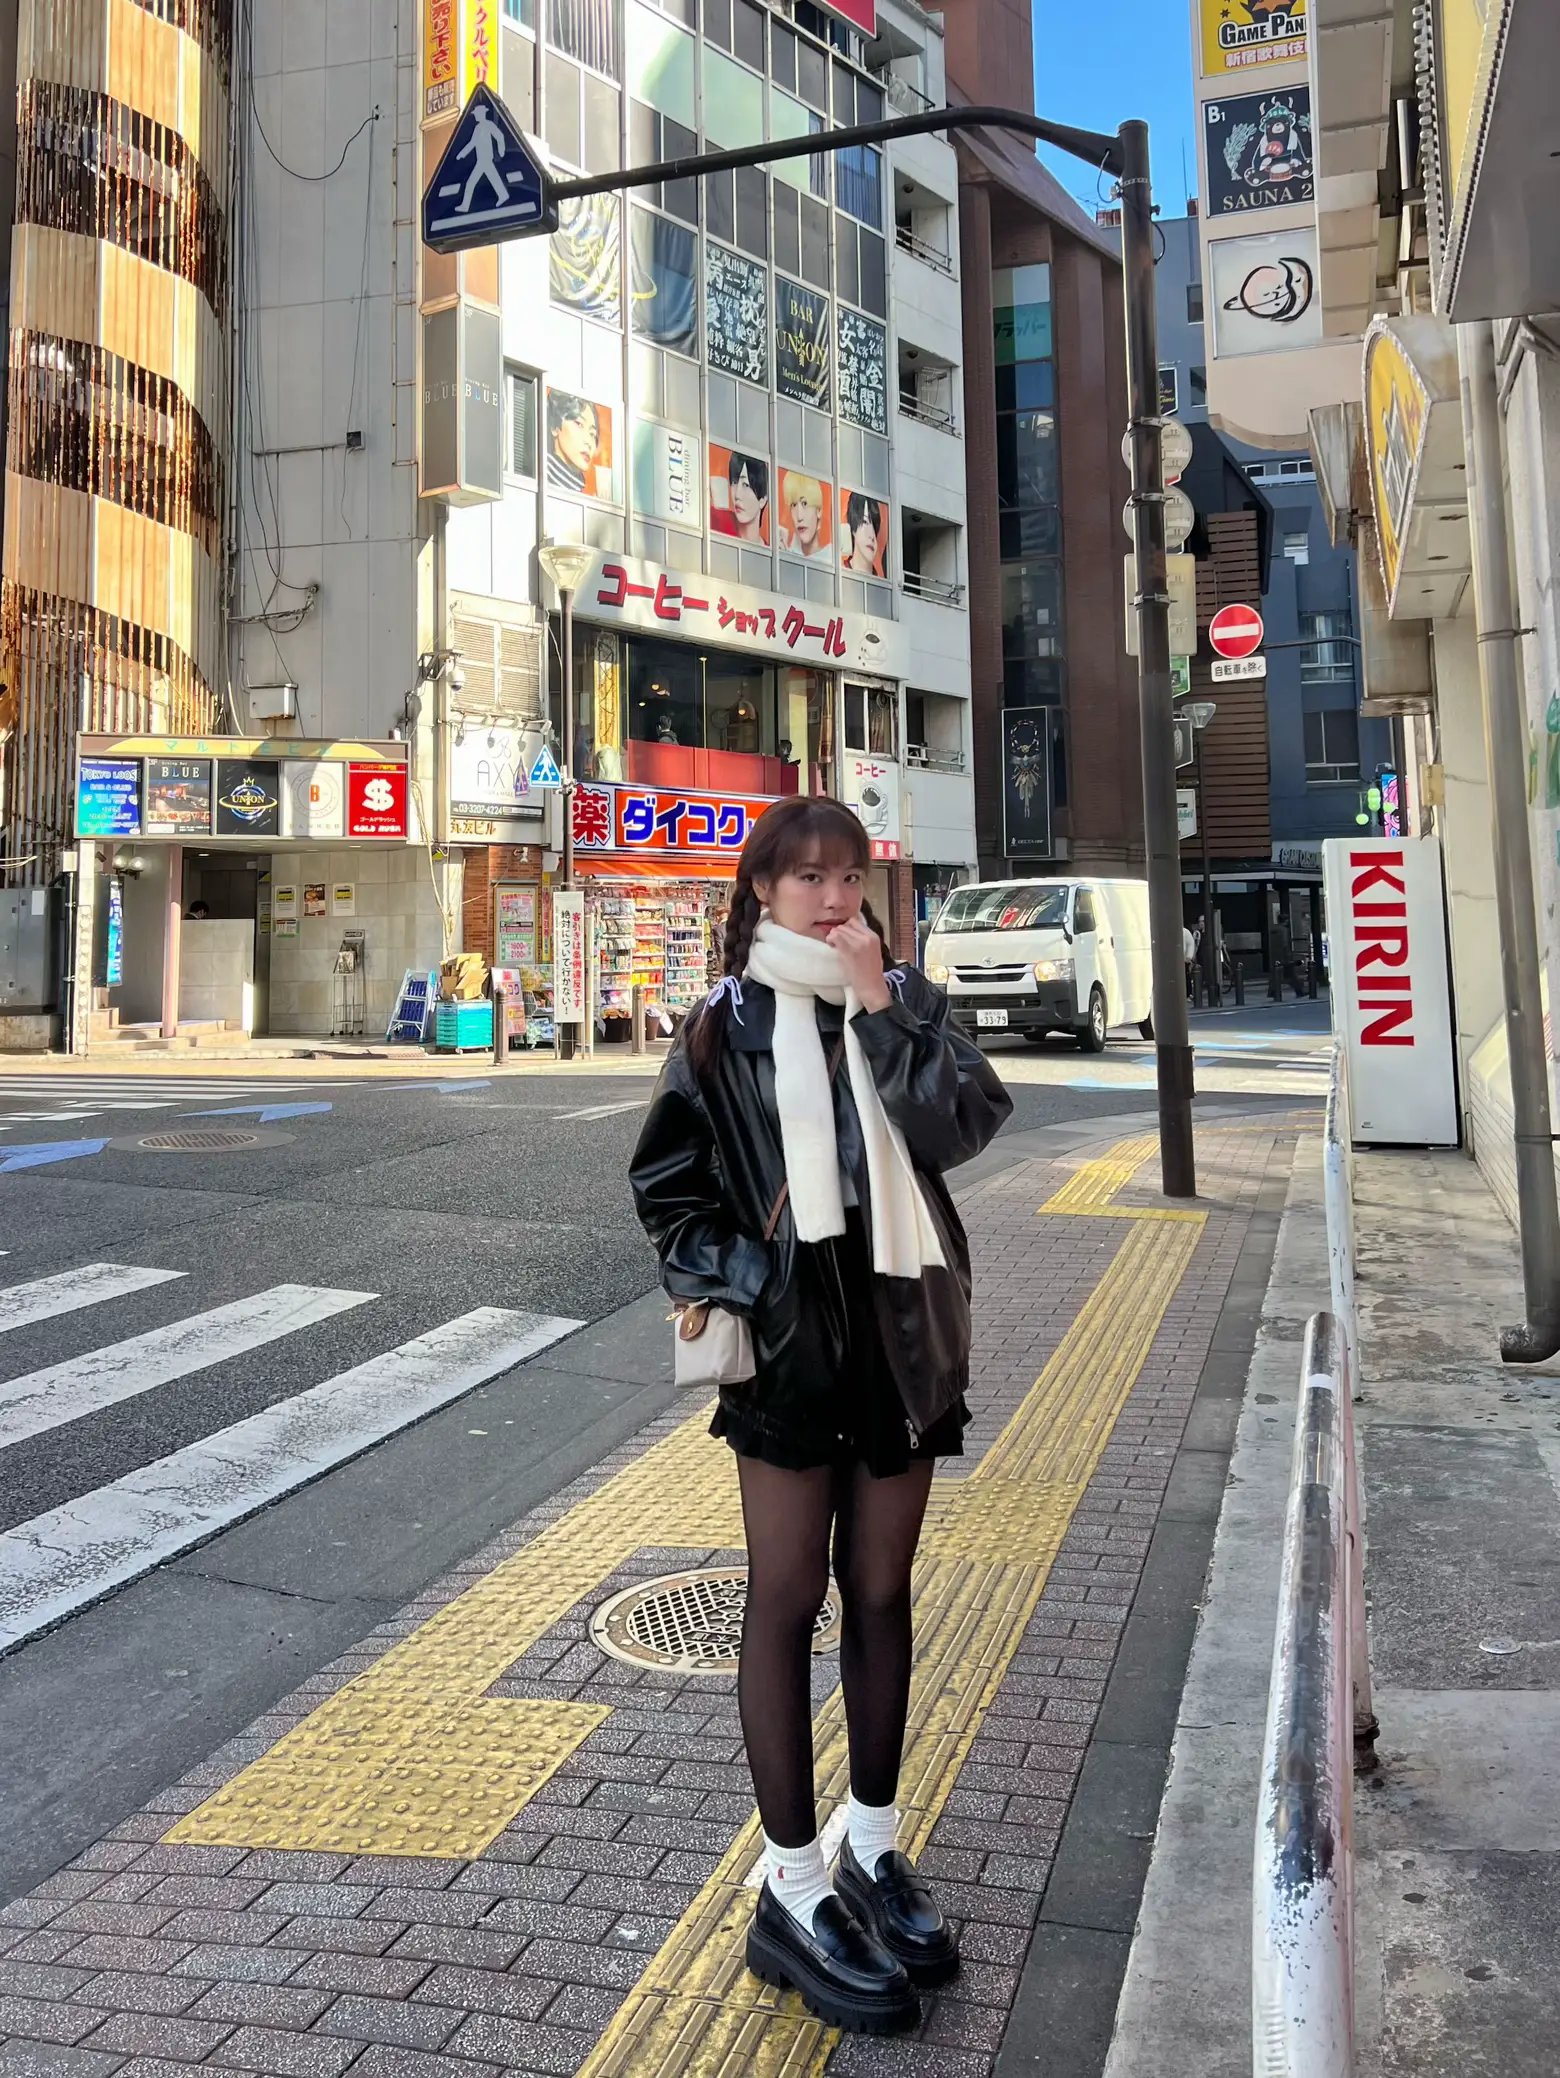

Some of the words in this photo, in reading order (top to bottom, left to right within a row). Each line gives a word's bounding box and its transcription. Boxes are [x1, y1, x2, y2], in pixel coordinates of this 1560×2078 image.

[472, 0, 489, 83] クルベリ
[1221, 23, 1267, 45] GAME
[1225, 40, 1308, 67] 新宿歌舞伎
[1208, 105, 1226, 124] B1
[1223, 187, 1294, 211] SAUNA
[1301, 183, 1313, 199] 2
[790, 298, 814, 324] BAR
[839, 320, 857, 353] 女
[744, 348, 762, 381] 男
[866, 359, 884, 391] 金
[425, 384, 457, 404] BLUE
[465, 383, 498, 407] BLUE
[668, 436, 684, 513] BLUE
[597, 563, 847, 657] コーヒーショップクール
[1214, 661, 1263, 677] 自転車を除く
[81, 767, 111, 781] TOKYO
[161, 767, 200, 778] BLUE
[856, 762, 886, 778] コーヒー
[573, 784, 609, 843] 薬
[623, 797, 747, 846] ダイコク
[572, 912, 583, 1009] 客引きは条例違反です
[1350, 851, 1415, 1047] KIRIN
